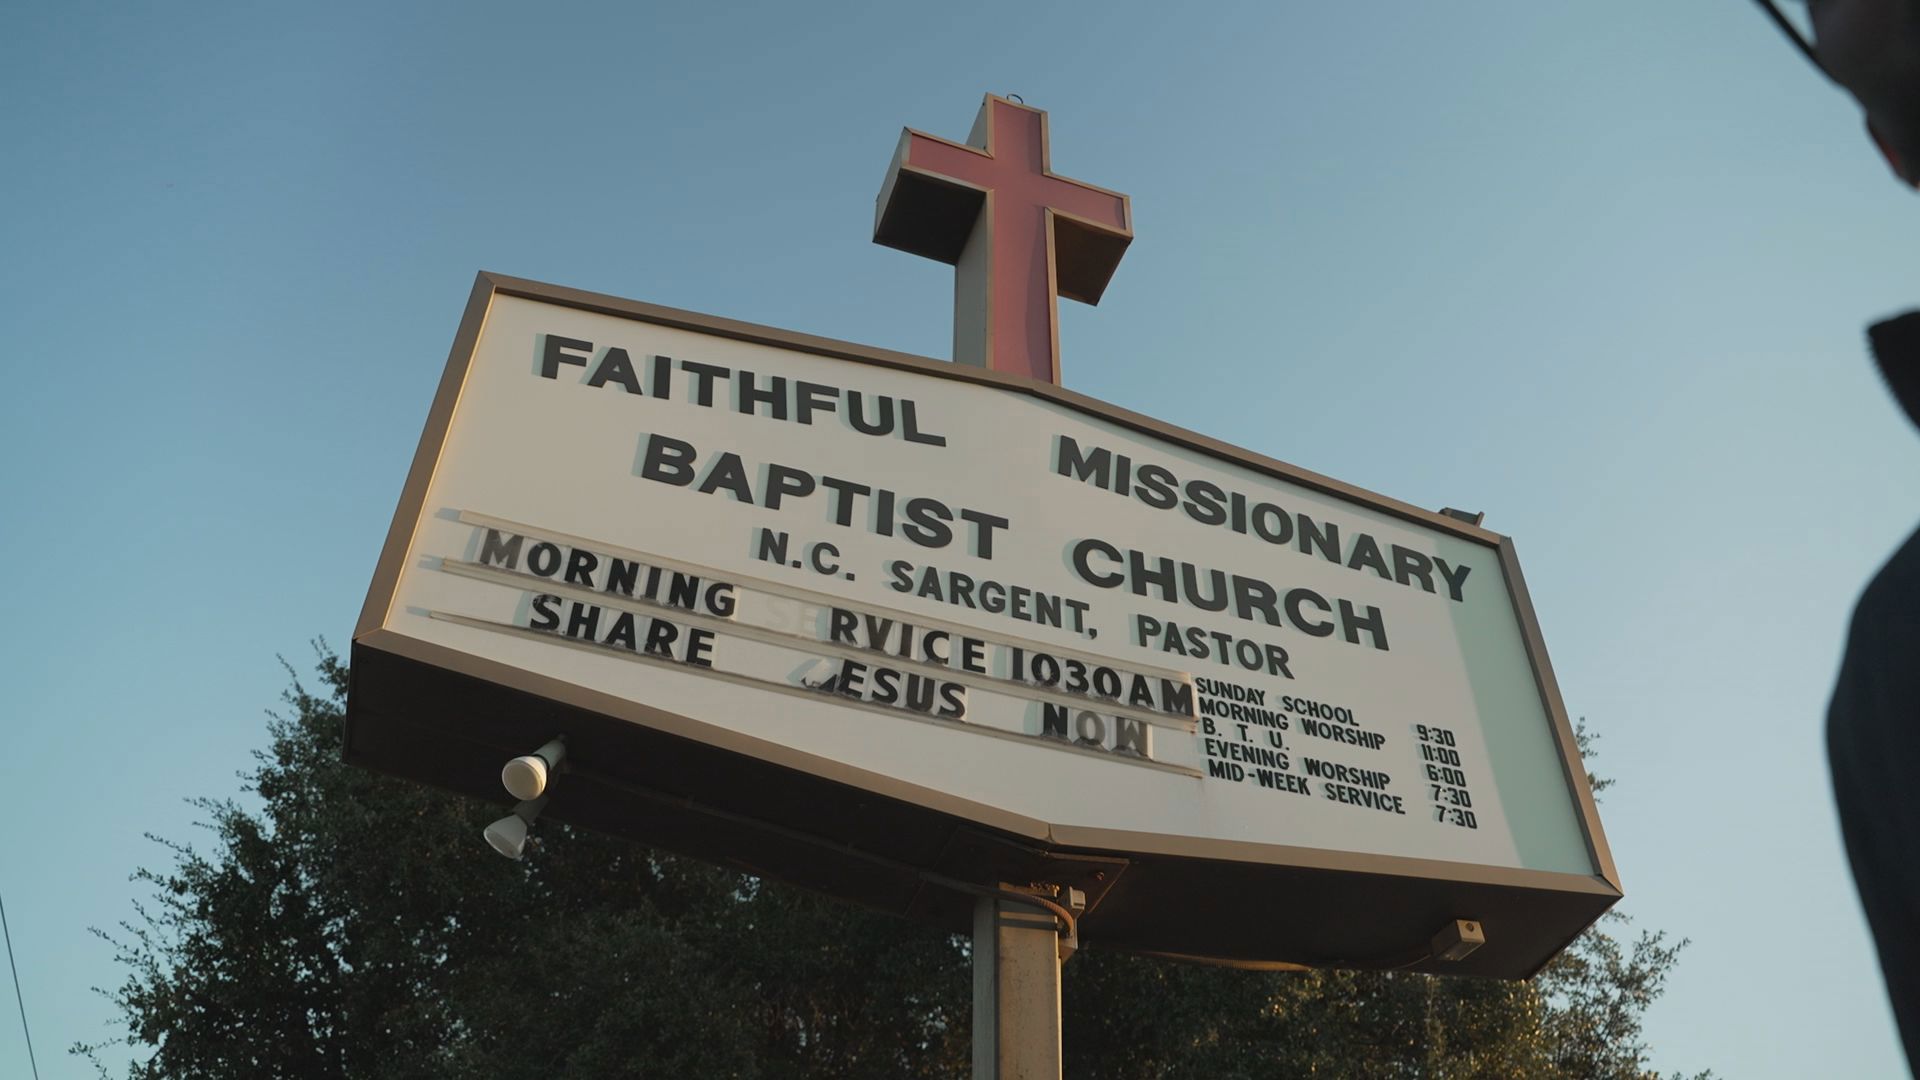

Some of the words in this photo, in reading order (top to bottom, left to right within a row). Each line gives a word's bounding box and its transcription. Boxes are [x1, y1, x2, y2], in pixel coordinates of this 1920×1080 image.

[541, 334, 946, 447] FAITHFUL
[1058, 435, 1471, 602] MISSIONARY
[479, 528, 737, 618] MORNING
[641, 433, 1009, 560] BAPTIST
[1072, 538, 1390, 651] CHURCH
[758, 527, 856, 582] N.C.
[890, 560, 1098, 640] SARGENT,
[1137, 614, 1295, 680] PASTOR
[529, 593, 715, 668] SHARE
[1041, 701, 1150, 756] NOW
[1195, 677, 1266, 706] SUNDAY
[1282, 695, 1360, 727] SCHOOL
[1416, 724, 1456, 748] 9:30
[1198, 697, 1289, 731] MORNING
[1300, 717, 1386, 751] WORSHIP
[1422, 743, 1461, 768] 11:00
[1202, 717, 1222, 737] B.
[1236, 724, 1254, 743] T.
[1269, 731, 1290, 751] U.
[1426, 764, 1466, 788] 6:00
[1204, 738, 1290, 771] EVENING
[1304, 757, 1391, 791] WORSHIP
[1431, 784, 1472, 809] 7:30
[1207, 758, 1311, 797] MID-WEEK
[1324, 782, 1406, 815] SERVICE
[1436, 805, 1478, 830] 7:30
